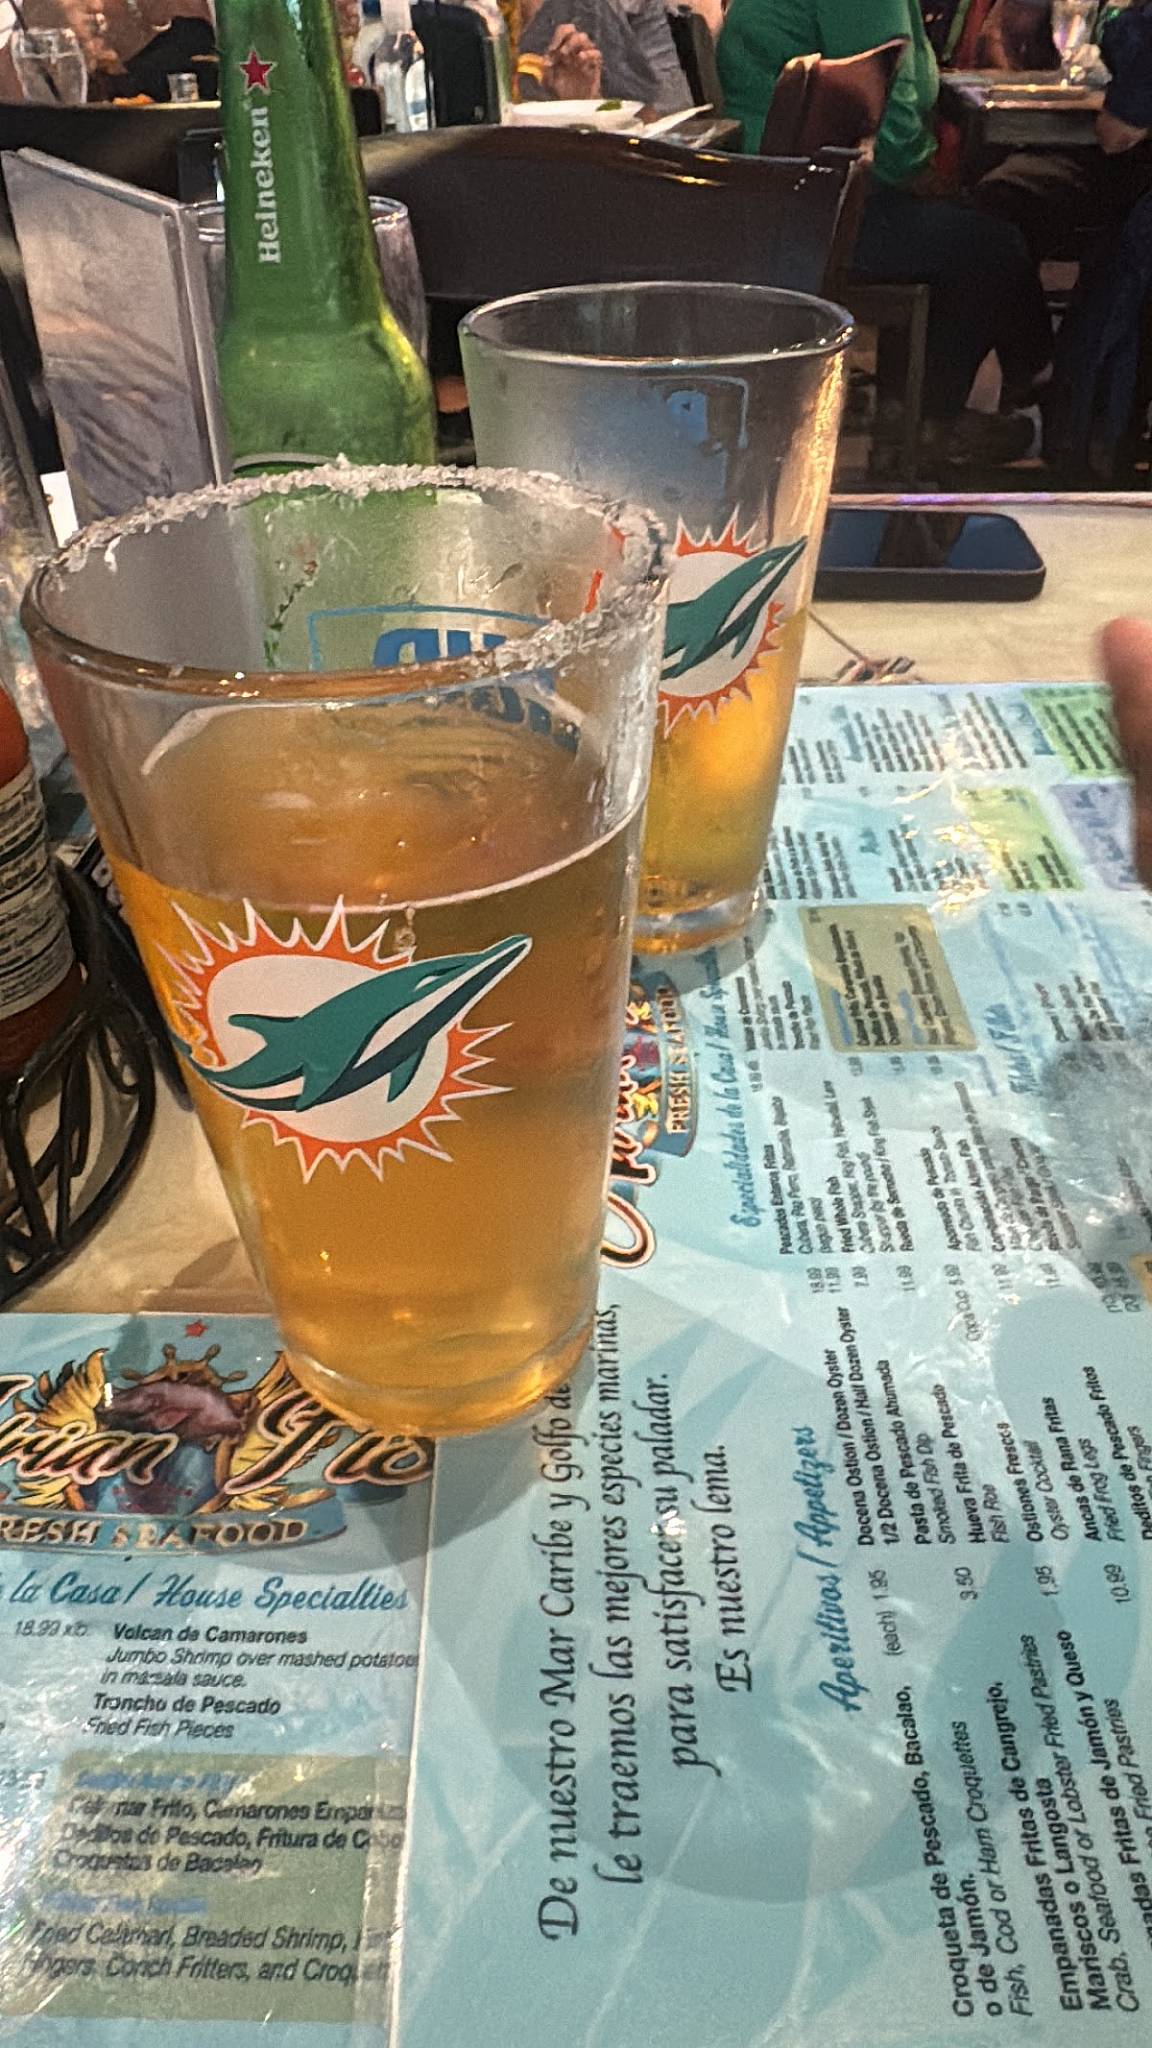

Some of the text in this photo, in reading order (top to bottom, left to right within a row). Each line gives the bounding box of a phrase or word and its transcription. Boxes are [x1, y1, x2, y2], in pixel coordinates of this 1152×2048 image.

[250, 106, 281, 263] Heineken
[665, 1070, 690, 1135] FRESH
[836, 1306, 856, 1343] Oyster
[822, 1348, 843, 1388] Oyster
[844, 1344, 864, 1381] Dozen
[833, 1391, 852, 1430] Dozen
[852, 1383, 869, 1408] Half
[532, 1417, 589, 1482] Golfo
[632, 1372, 694, 1483] paladar.
[860, 1417, 880, 1461] Ostion
[889, 1420, 916, 1478] Pescado
[944, 1441, 962, 1459] de
[1082, 1365, 1152, 1540] Deditos de Pescado Fritos
[791, 1424, 841, 1548] Appetizers
[840, 1440, 863, 1486] Ostion
[921, 1458, 940, 1484] Fish
[950, 1461, 974, 1493] Frita
[1042, 1396, 1102, 1541] Ancas de Rana Fritas
[549, 1492, 590, 1511] y
[653, 1484, 678, 1514] su
[869, 1464, 895, 1519] Docena
[902, 1481, 919, 1500] de
[1014, 1477, 1044, 1542] Ostiones
[1077, 1437, 1126, 1542] Fried Frog Legs
[0, 1514, 308, 1549] RESH SEAFOOD
[849, 1490, 876, 1546] Docena
[881, 1522, 900, 1544] 1/2
[910, 1502, 932, 1544] Pasta
[960, 1497, 987, 1543] Hueva
[1042, 1496, 1070, 1541] Oyster
[9, 1569, 42, 1603] la
[50, 1571, 122, 1605] Casa
[153, 1574, 243, 1610] House
[254, 1575, 409, 1618] Specialties
[532, 1519, 574, 1617] Caribe
[588, 1302, 649, 1884] le traemos las mejores especies marinas,
[691, 1444, 752, 1692] Es nuestro lema.
[954, 1566, 978, 1600] 3.50
[105, 1646, 168, 1665] Jumbo
[170, 1647, 232, 1668] Shrimp
[236, 1653, 274, 1667] over
[277, 1650, 345, 1668] mashed
[113, 1622, 308, 1644] Volcan de Camarones
[813, 1574, 869, 1712] Aperitivos
[876, 1609, 904, 1656] (each)
[1056, 1629, 1086, 1686] Queso
[539, 1627, 575, 1706] Mar
[172, 1696, 196, 1712] de
[200, 1695, 281, 1715] Pescado
[1071, 1690, 1094, 1702] y
[668, 1683, 721, 1778] para
[1078, 1705, 1112, 1770] Jamón
[1103, 1697, 1140, 1768] Pastries
[544, 1718, 578, 1861] nuestro
[1100, 1775, 1120, 1800] de
[164, 1826, 250, 1850] Pescado,
[322, 1830, 348, 1849] de
[985, 1681, 1084, 2011] Empanadas Fritas de Cangrejo,
[1020, 1633, 1140, 2012] Crab, Seafood or Lobster Fried Pastries
[1112, 1805, 1142, 1864] Fritas
[156, 1851, 180, 1872] de
[895, 1684, 974, 2017] Croqueta de Pescado, Bacalao,
[951, 1720, 1033, 2017] Fish, Cod or Ham Croquettes
[538, 1876, 578, 1940] De
[1034, 1777, 1112, 2011] Mariscos o Langosta
[181, 1924, 268, 1950] Breaded
[271, 1925, 348, 1953] Shrimp,
[956, 1872, 1002, 2016] o de Jamón.
[257, 1958, 299, 1981] and
